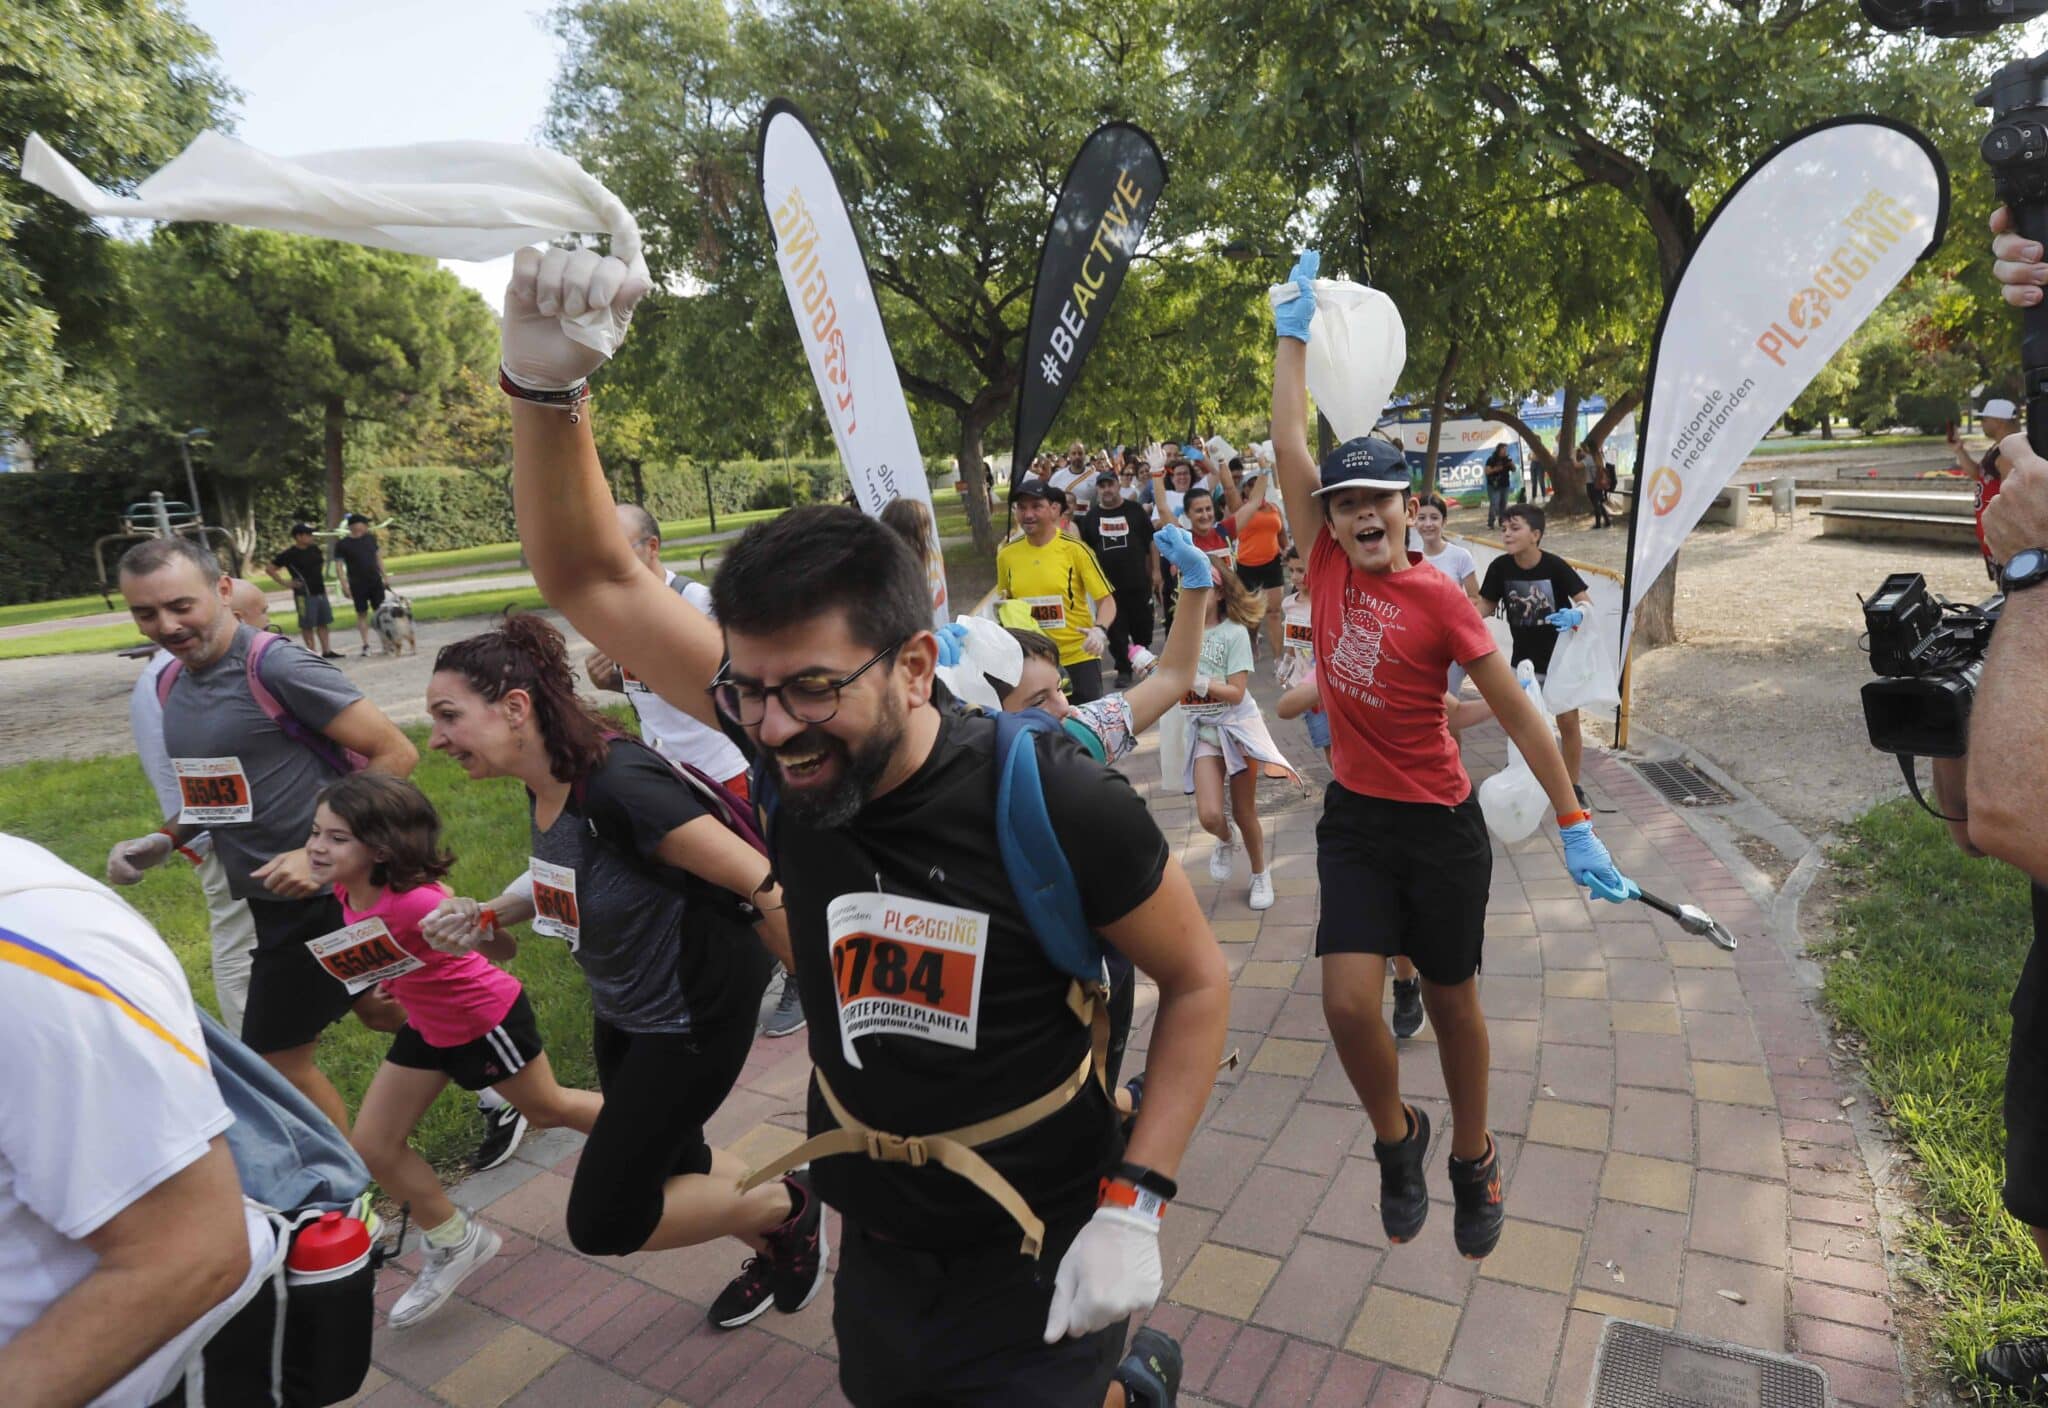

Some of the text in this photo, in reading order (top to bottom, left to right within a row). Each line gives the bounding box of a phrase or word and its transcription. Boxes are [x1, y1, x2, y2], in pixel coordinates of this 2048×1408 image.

[1040, 169, 1143, 386] #BEACTIVE
[1756, 195, 1917, 367] PLOGGING
[1671, 389, 1723, 460] nationale
[1683, 378, 1755, 470] nederlanden
[1439, 464, 1484, 481] EXPO
[1031, 605, 1058, 621] 436
[186, 777, 238, 804] 5543
[884, 910, 976, 946] PLOGGING
[330, 940, 396, 977] 5544
